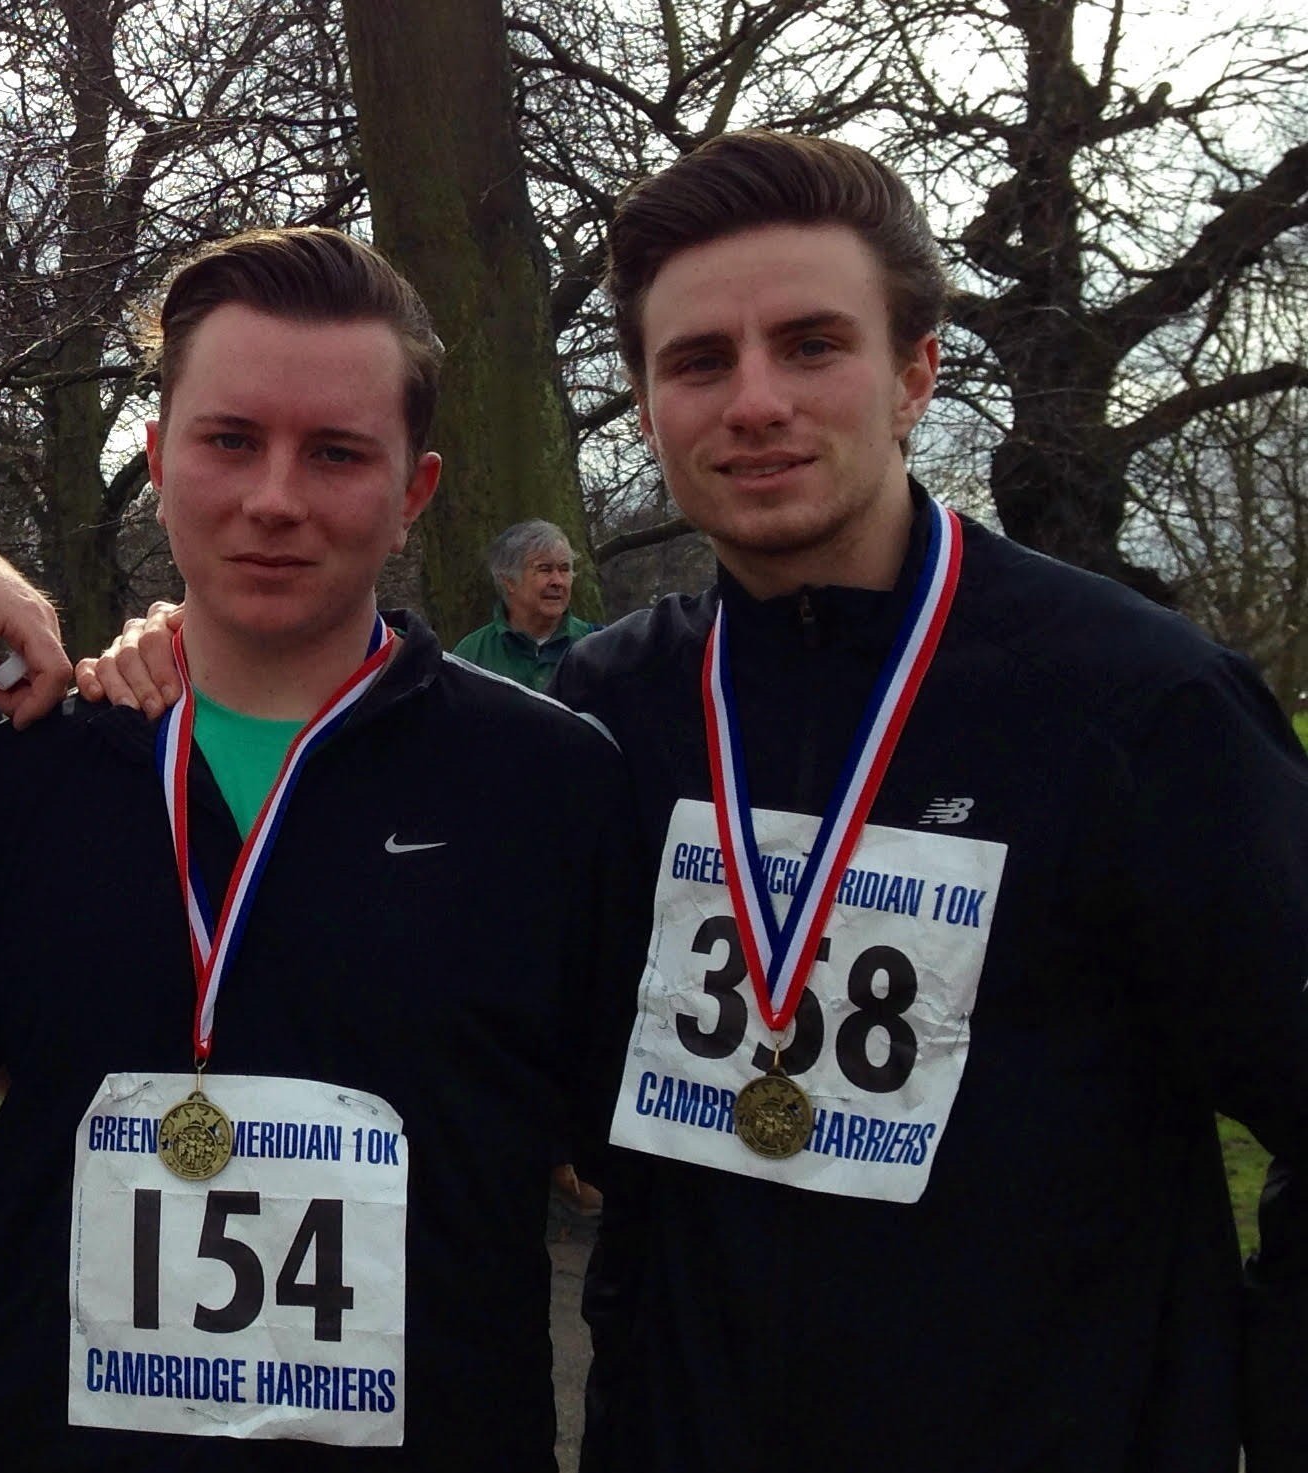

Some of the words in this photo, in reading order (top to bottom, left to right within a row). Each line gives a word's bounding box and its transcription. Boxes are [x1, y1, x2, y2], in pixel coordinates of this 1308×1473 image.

[672, 842, 800, 896] GREEICH
[834, 868, 925, 917] RIDIAN
[931, 882, 986, 928] 10K
[89, 1115, 166, 1154] GREEN
[232, 1121, 342, 1162] MERIDIAN
[352, 1127, 400, 1166] 10K
[636, 1071, 740, 1136] CAMBR
[803, 1107, 937, 1165] HARRIERS
[133, 1188, 354, 1342] 154
[86, 1347, 246, 1403] CAMBRIDGE
[257, 1360, 396, 1414] HARRIERS
